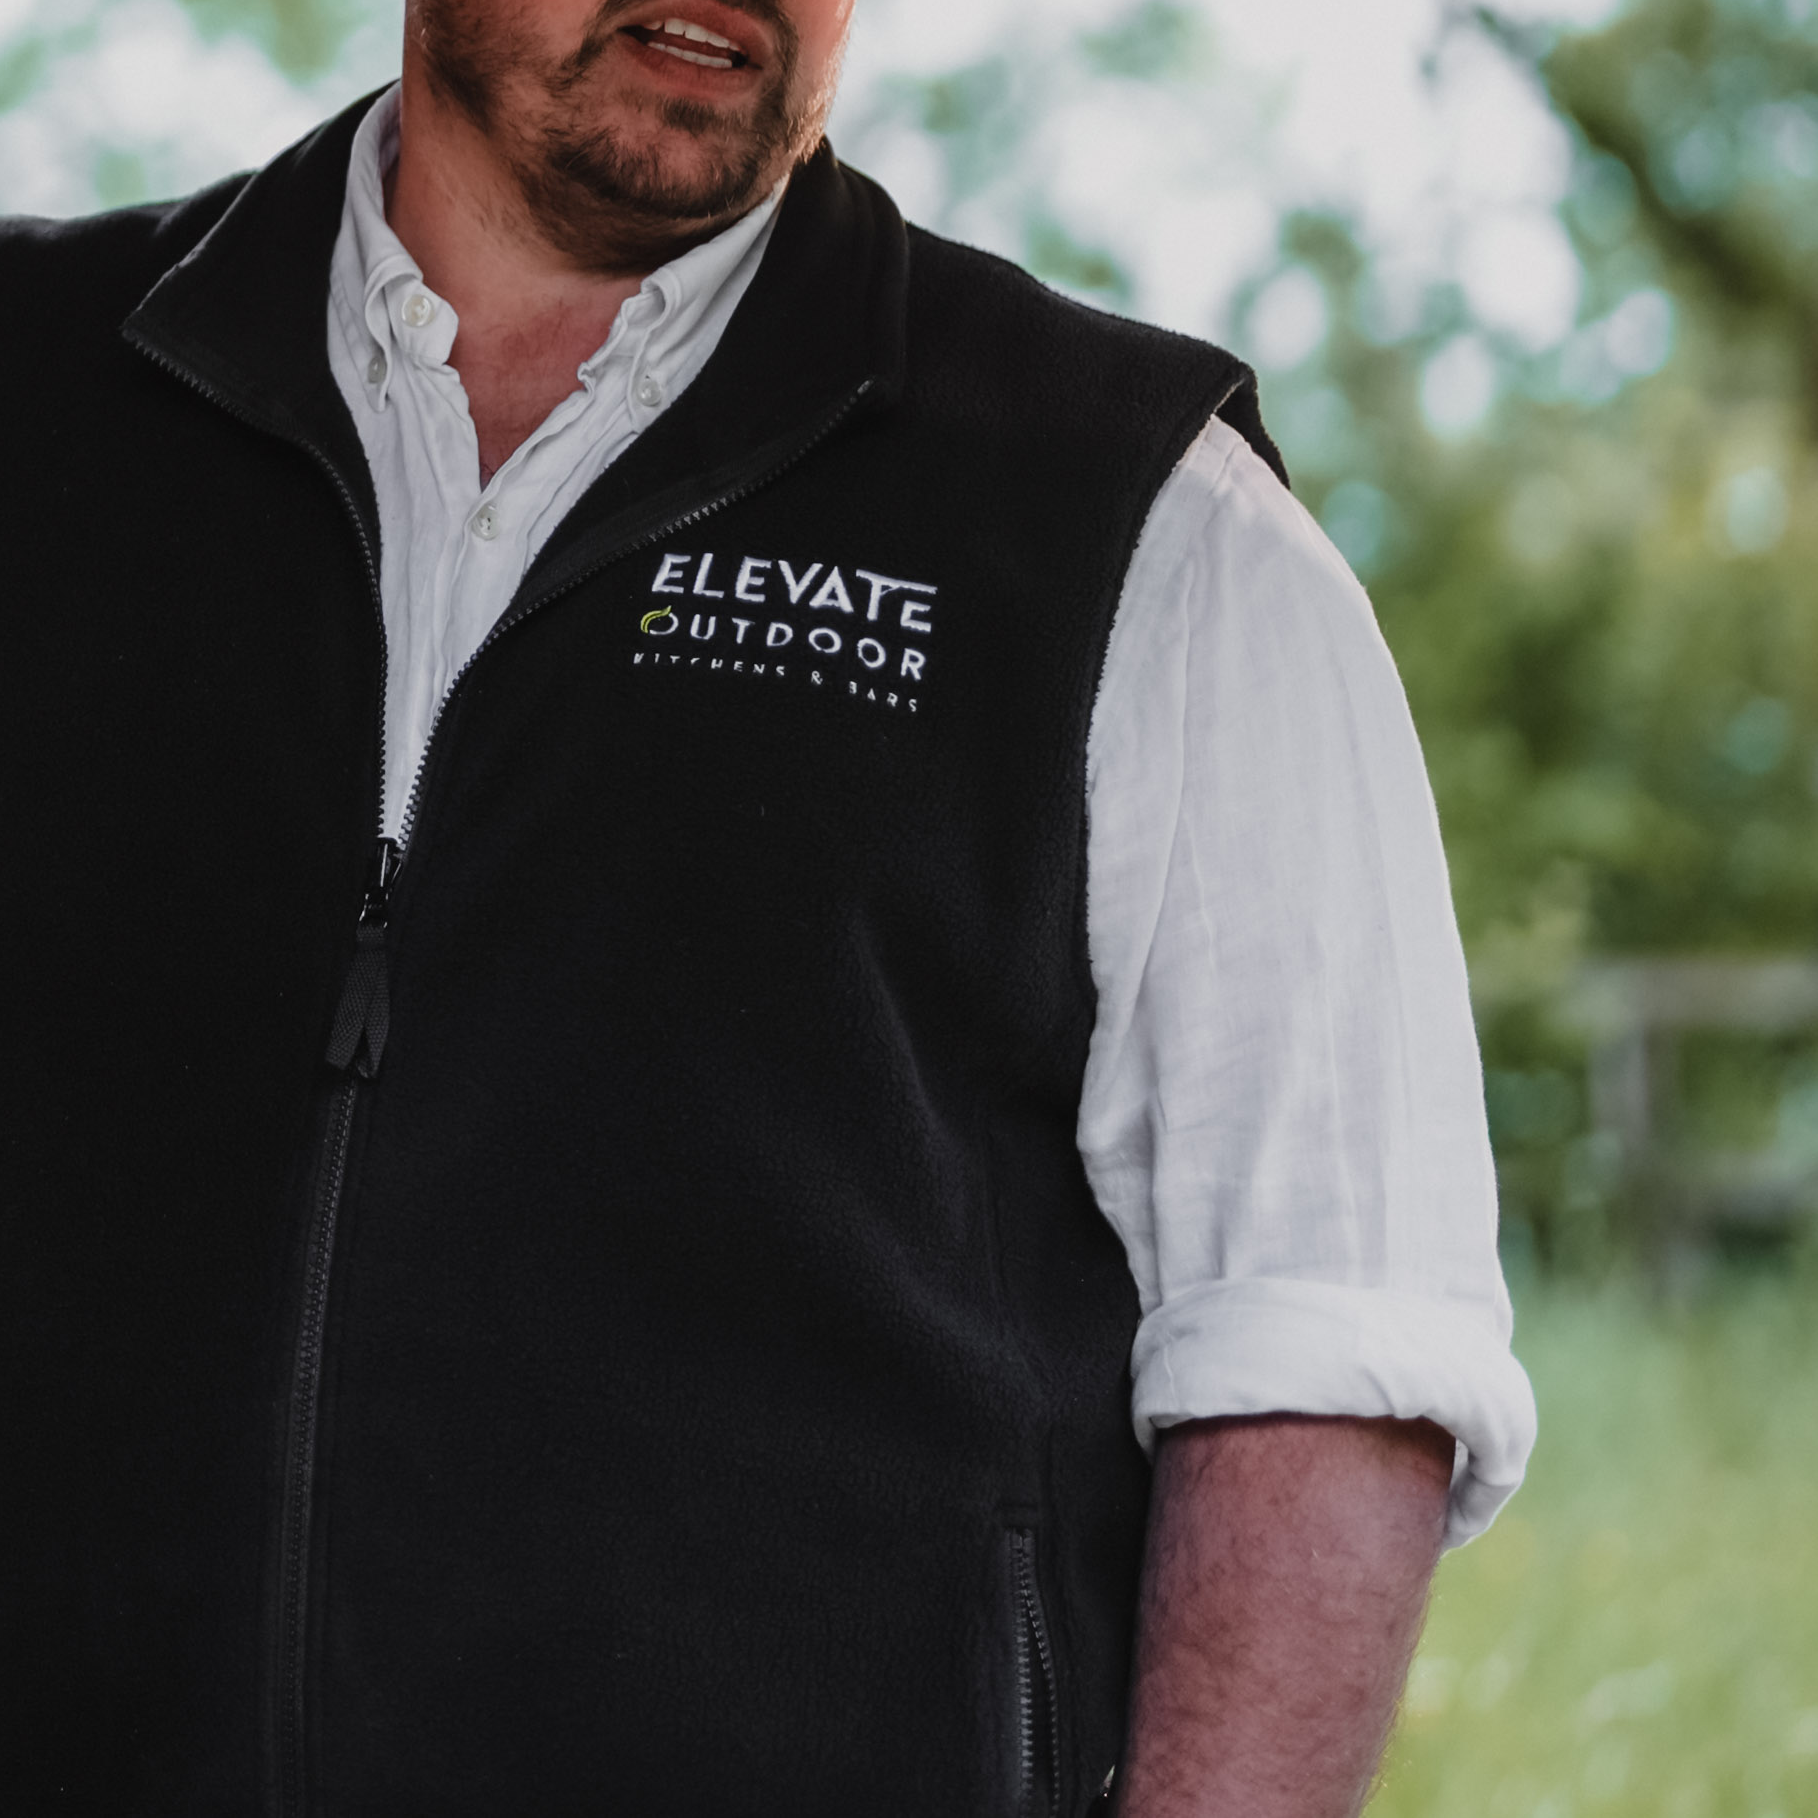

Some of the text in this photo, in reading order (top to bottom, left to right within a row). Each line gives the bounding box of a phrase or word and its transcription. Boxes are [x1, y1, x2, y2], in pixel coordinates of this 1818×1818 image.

[651, 552, 938, 633] ELEVATE
[640, 604, 927, 682] OUTDOOR
[810, 670, 824, 685] &
